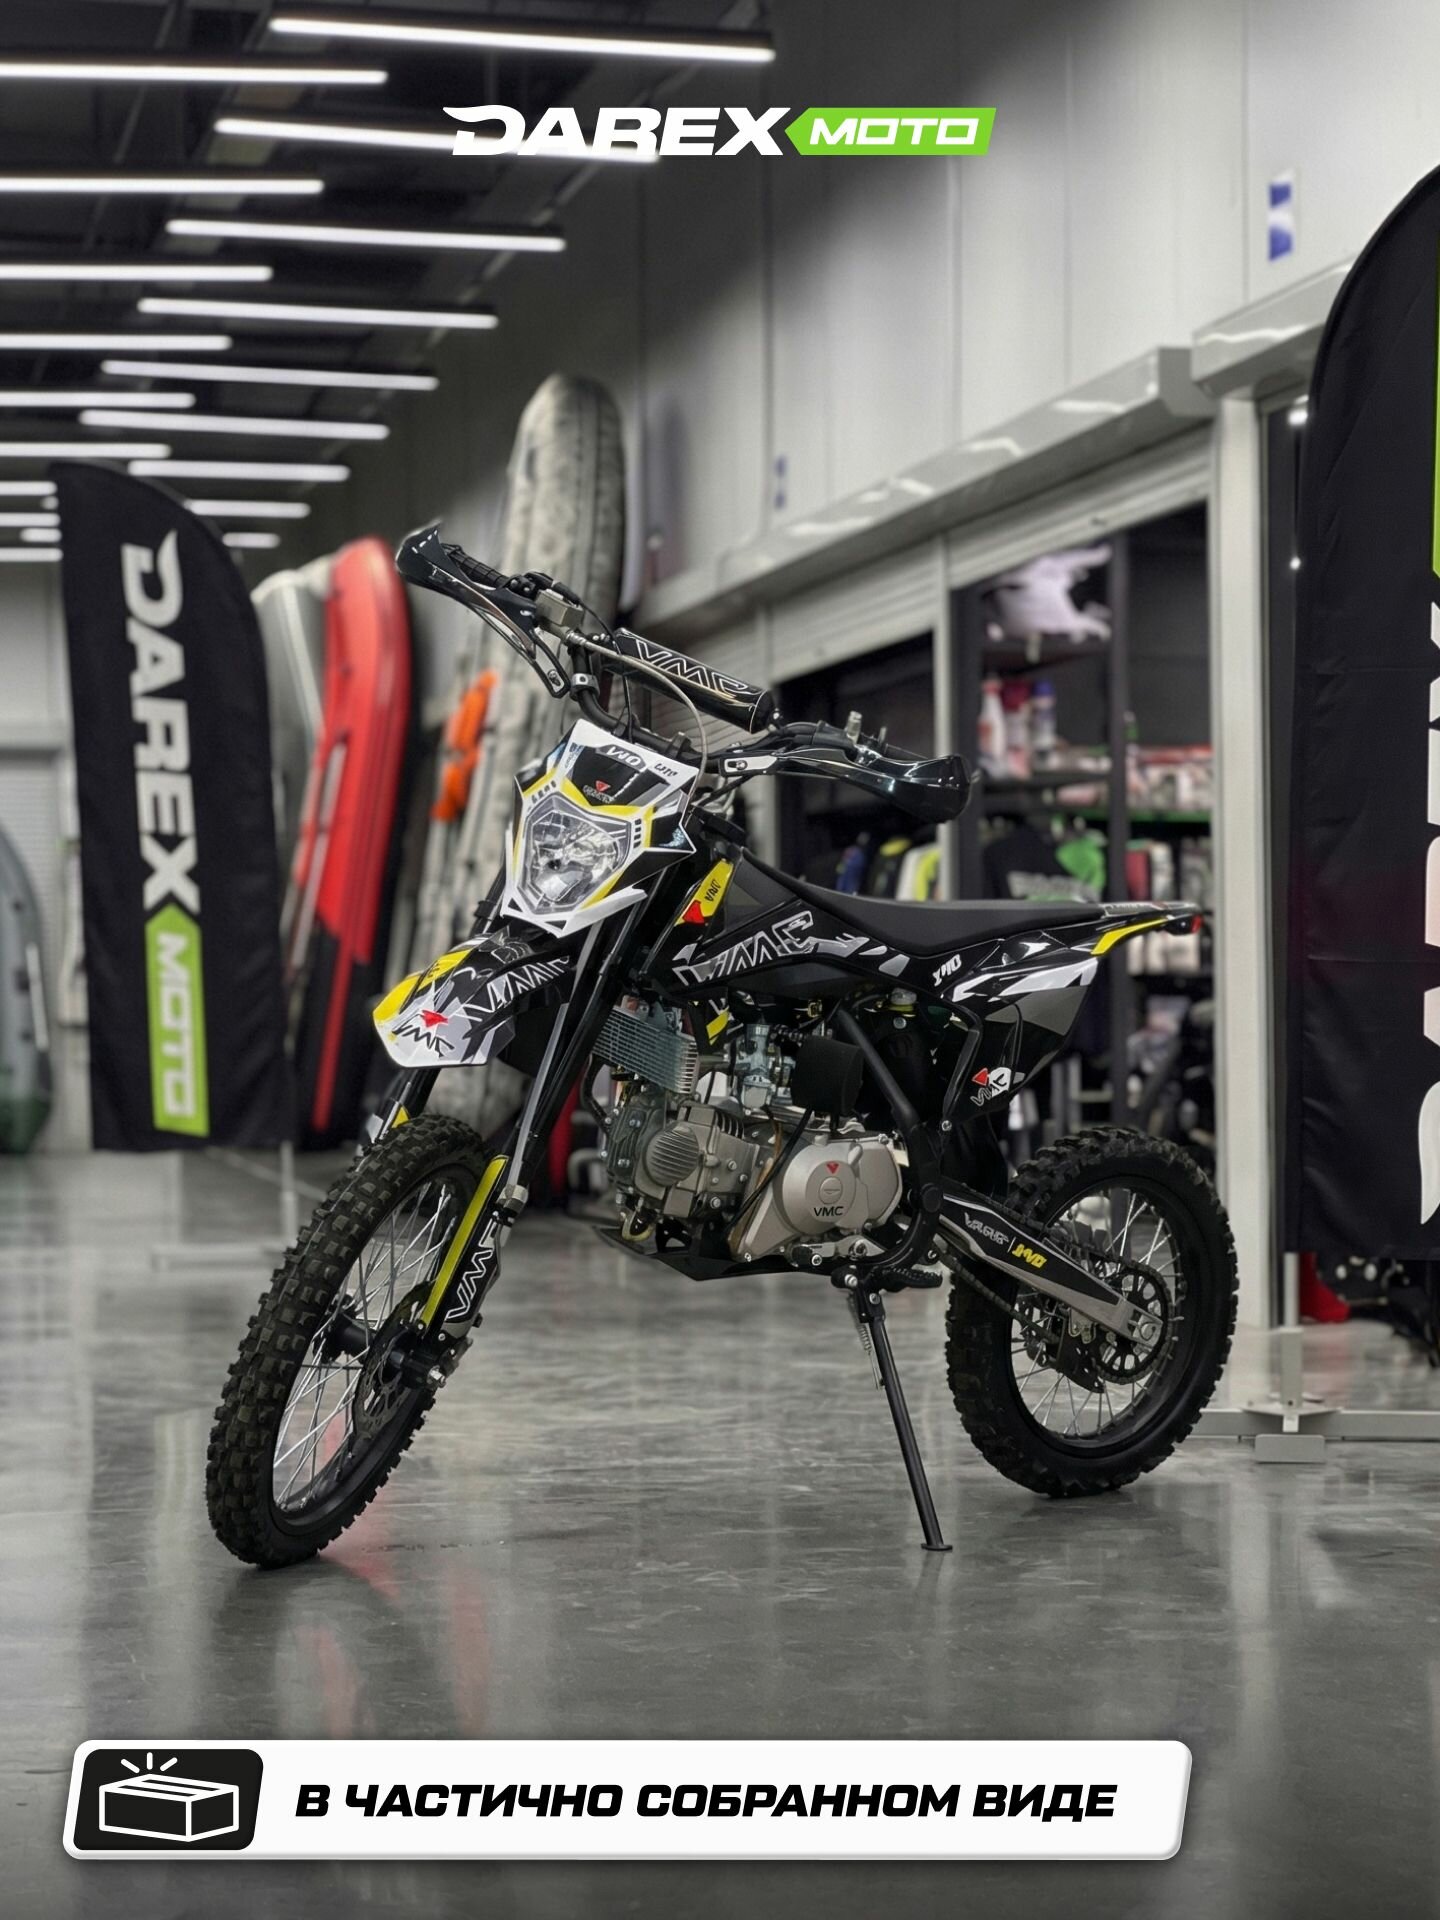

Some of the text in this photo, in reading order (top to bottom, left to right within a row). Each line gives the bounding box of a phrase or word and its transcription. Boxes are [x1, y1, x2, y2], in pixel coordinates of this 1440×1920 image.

[636, 639, 749, 699] VMC
[121, 530, 200, 1117] DAREX MOTO
[813, 1206, 844, 1217] VMC
